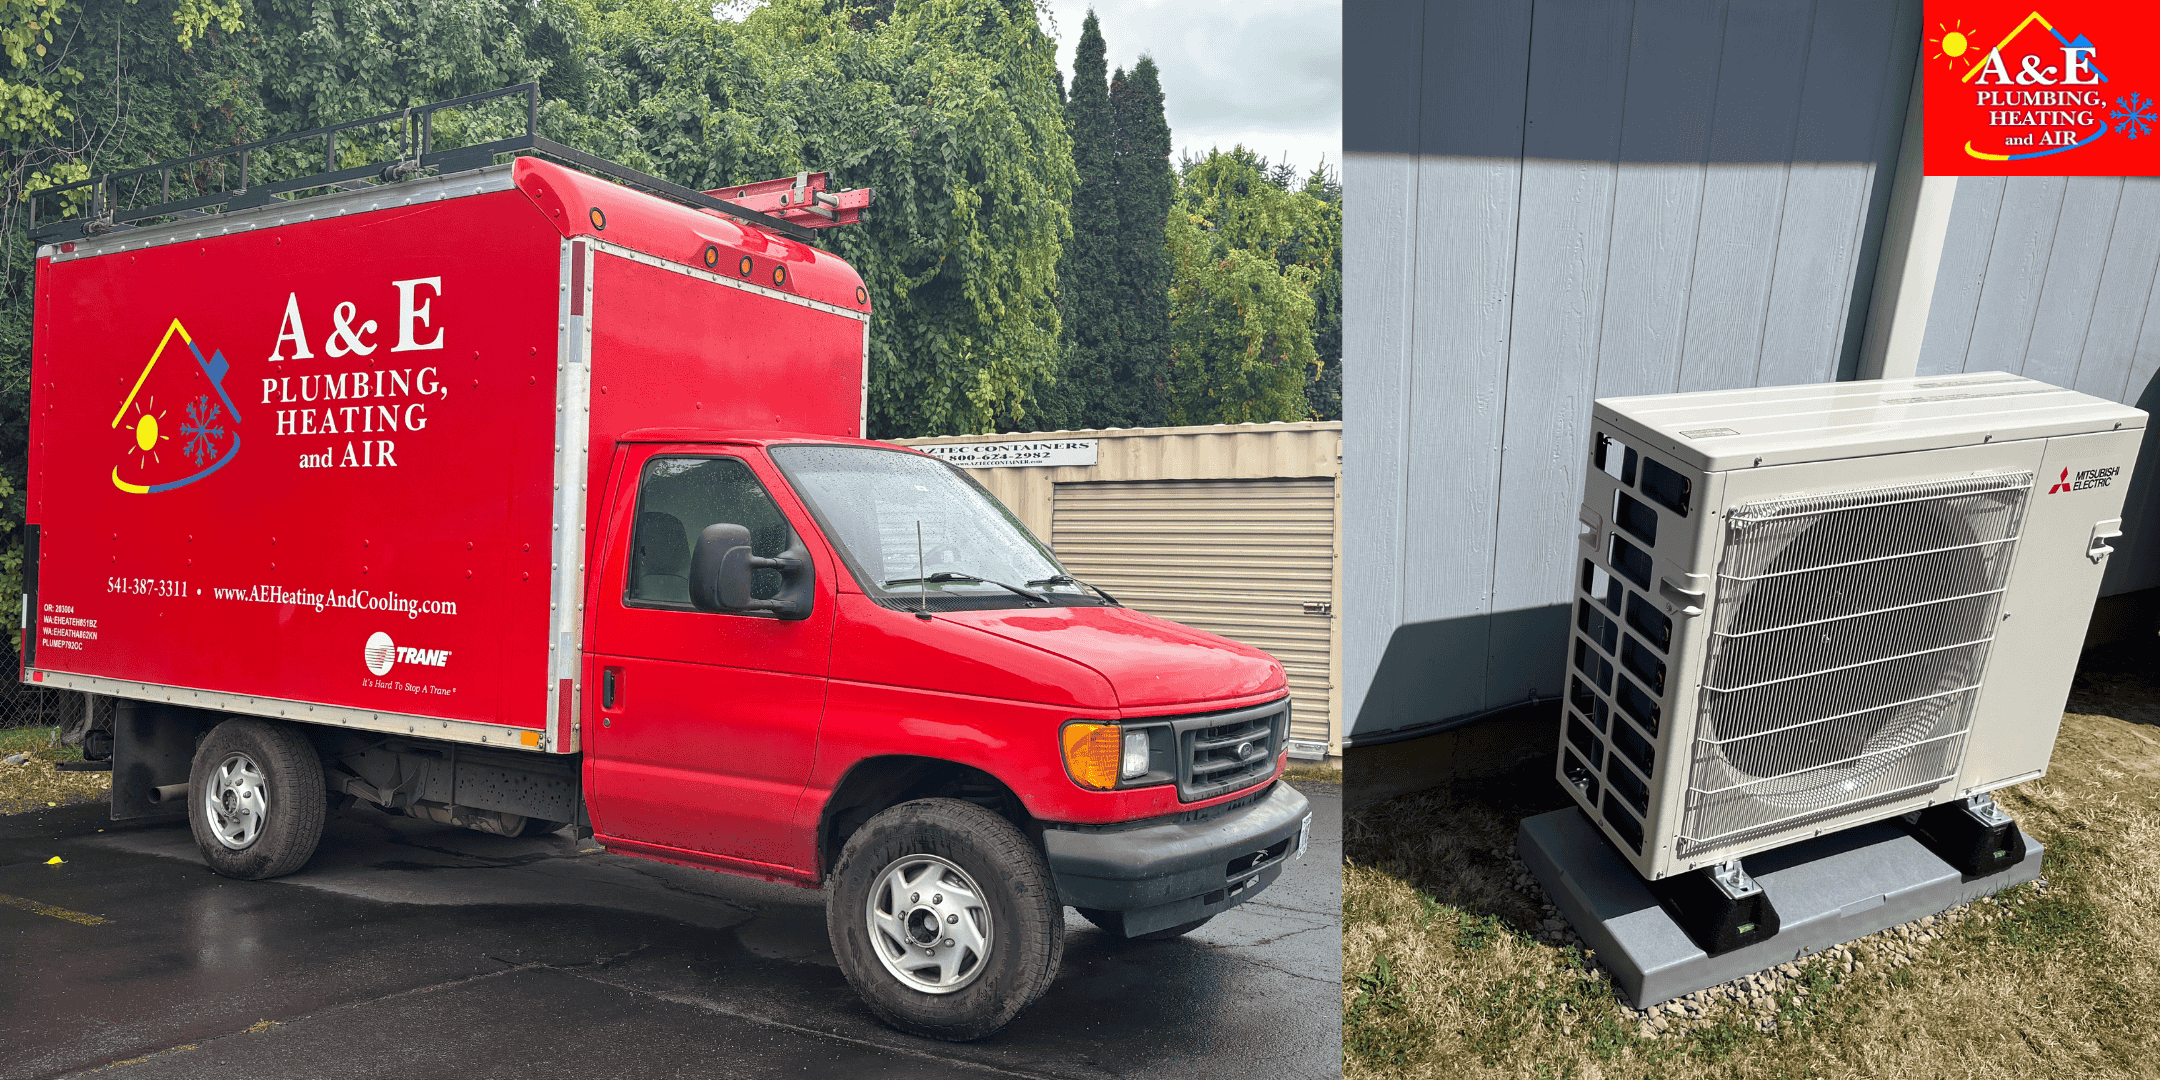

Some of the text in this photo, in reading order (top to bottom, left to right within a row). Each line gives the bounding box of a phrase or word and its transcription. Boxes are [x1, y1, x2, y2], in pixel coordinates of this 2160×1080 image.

[261, 366, 448, 404] PLUMBING,
[275, 403, 428, 436] HEATING
[299, 440, 398, 469] and AIR
[973, 443, 1090, 453] CONTAINERS
[949, 452, 1051, 461] 800-624-2982
[2075, 466, 2120, 481] MITSUBISHI
[2072, 477, 2112, 491] ELECTRIC
[107, 576, 458, 620] 541-387-3311 www.AEHeatingAndCooling.com
[374, 680, 393, 690] Hard
[394, 681, 403, 691] To
[404, 682, 421, 694] Stop
[421, 685, 428, 694] A
[429, 685, 452, 696] Trane
